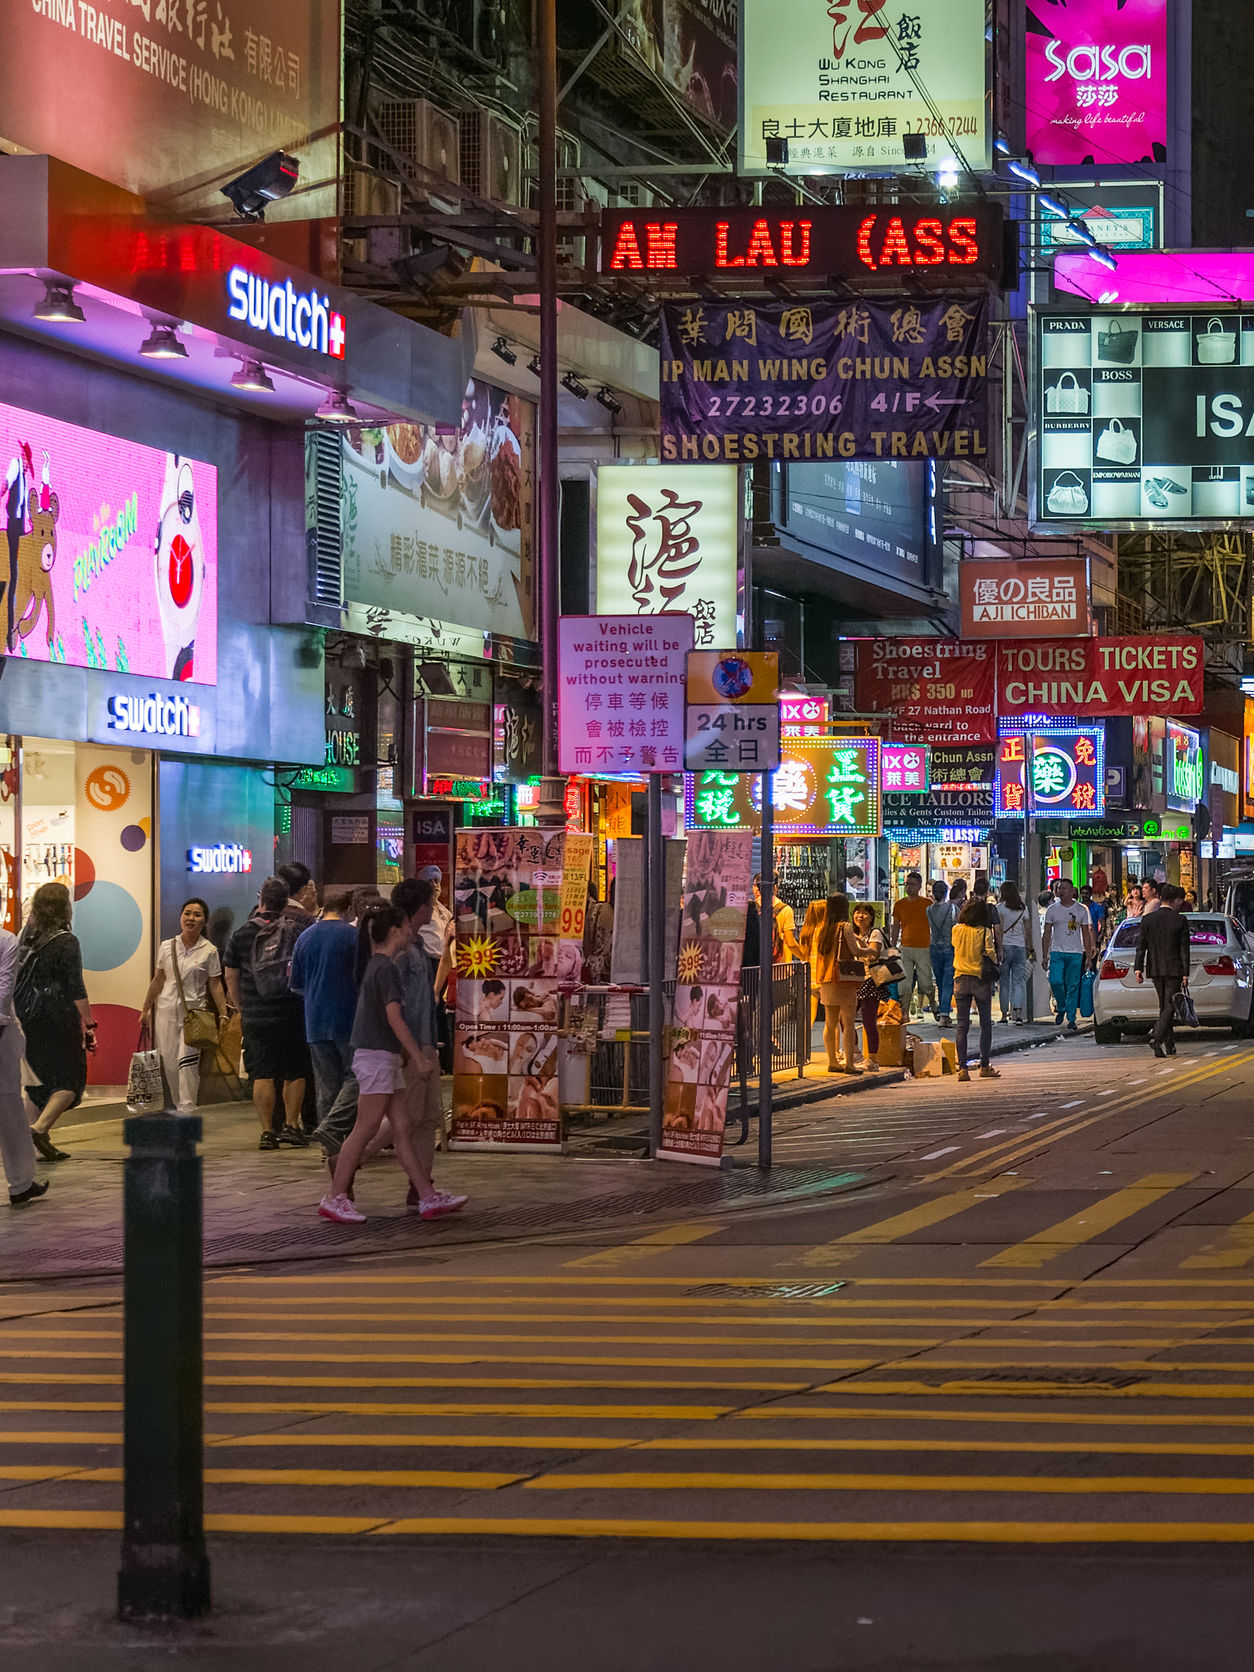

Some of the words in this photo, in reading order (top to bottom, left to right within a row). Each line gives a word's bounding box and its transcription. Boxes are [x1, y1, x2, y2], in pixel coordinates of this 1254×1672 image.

[896, 14, 921, 73] 飯店
[79, 1, 130, 60] TRAVEL
[133, 31, 187, 91] SERVICE
[190, 63, 228, 113] (HONG
[245, 25, 300, 99] 有限公司
[819, 90, 914, 101] RESTAURANT
[1076, 85, 1118, 107] 莎莎
[762, 116, 897, 139] 良士大廈地庫
[948, 116, 978, 135] 7244
[1050, 114, 1083, 129] making
[1084, 112, 1102, 128] life
[1104, 112, 1146, 127] beautiful
[716, 218, 812, 267] LAU
[857, 214, 979, 271] (ASS
[227, 265, 329, 354] swatch
[1049, 321, 1086, 330] PRADA
[1148, 320, 1185, 329] VERSACE
[663, 360, 683, 382] IP
[693, 359, 749, 382] MAN
[759, 358, 827, 381] WING
[837, 356, 912, 380] CHUN
[919, 355, 987, 378] ASSN
[1101, 370, 1133, 380] BOSS
[708, 395, 843, 417] 27232306
[870, 392, 921, 413] 4/F
[1044, 422, 1090, 430] BURBERRY
[663, 432, 857, 460] SHOESTRING
[870, 429, 988, 457] TRAVEL
[973, 576, 1077, 603] 優の良品
[979, 604, 1004, 621] AJI
[1010, 603, 1072, 620] ICHIBAN
[599, 623, 653, 636] Vehicle
[573, 640, 627, 653] waiting
[632, 640, 659, 652] will
[663, 640, 680, 651] be
[872, 641, 987, 661] Shoestring
[585, 656, 668, 672] prosecuted
[1002, 648, 1087, 672] TOURS
[1099, 646, 1198, 670] TICKETS
[872, 662, 942, 679] Travel
[566, 673, 625, 685] without
[628, 674, 686, 688] warning
[926, 683, 956, 699] 350
[961, 688, 974, 700] up
[1004, 680, 1108, 705] CHINA
[1118, 680, 1196, 702] VISA
[585, 692, 669, 712] 停車等候
[908, 706, 921, 715] 27
[924, 705, 963, 715] Nathan
[965, 704, 991, 714] Road
[115, 693, 189, 736] swatch
[697, 713, 727, 731] 24
[734, 713, 767, 731] hrs
[585, 719, 669, 738] 會被檢控
[956, 720, 969, 730] to
[927, 732, 981, 742] entrance
[326, 731, 361, 765] HOUSE
[575, 746, 679, 766] 而不予警告
[704, 739, 759, 763] 全日
[933, 752, 963, 764] Chun
[966, 751, 994, 763] Assn
[919, 791, 995, 806] TAILORS
[909, 808, 932, 816] Gents
[934, 808, 962, 816] Custom
[967, 808, 994, 816] Tailors
[417, 820, 446, 835] ISA
[918, 818, 931, 826] No.
[934, 818, 942, 826] 77
[944, 818, 972, 827] Peking
[974, 818, 994, 826] Road
[1070, 825, 1125, 836] International
[942, 828, 981, 842] CLASSY
[191, 844, 244, 873] swatch
[562, 907, 584, 934] 99
[459, 1023, 478, 1031] Open
